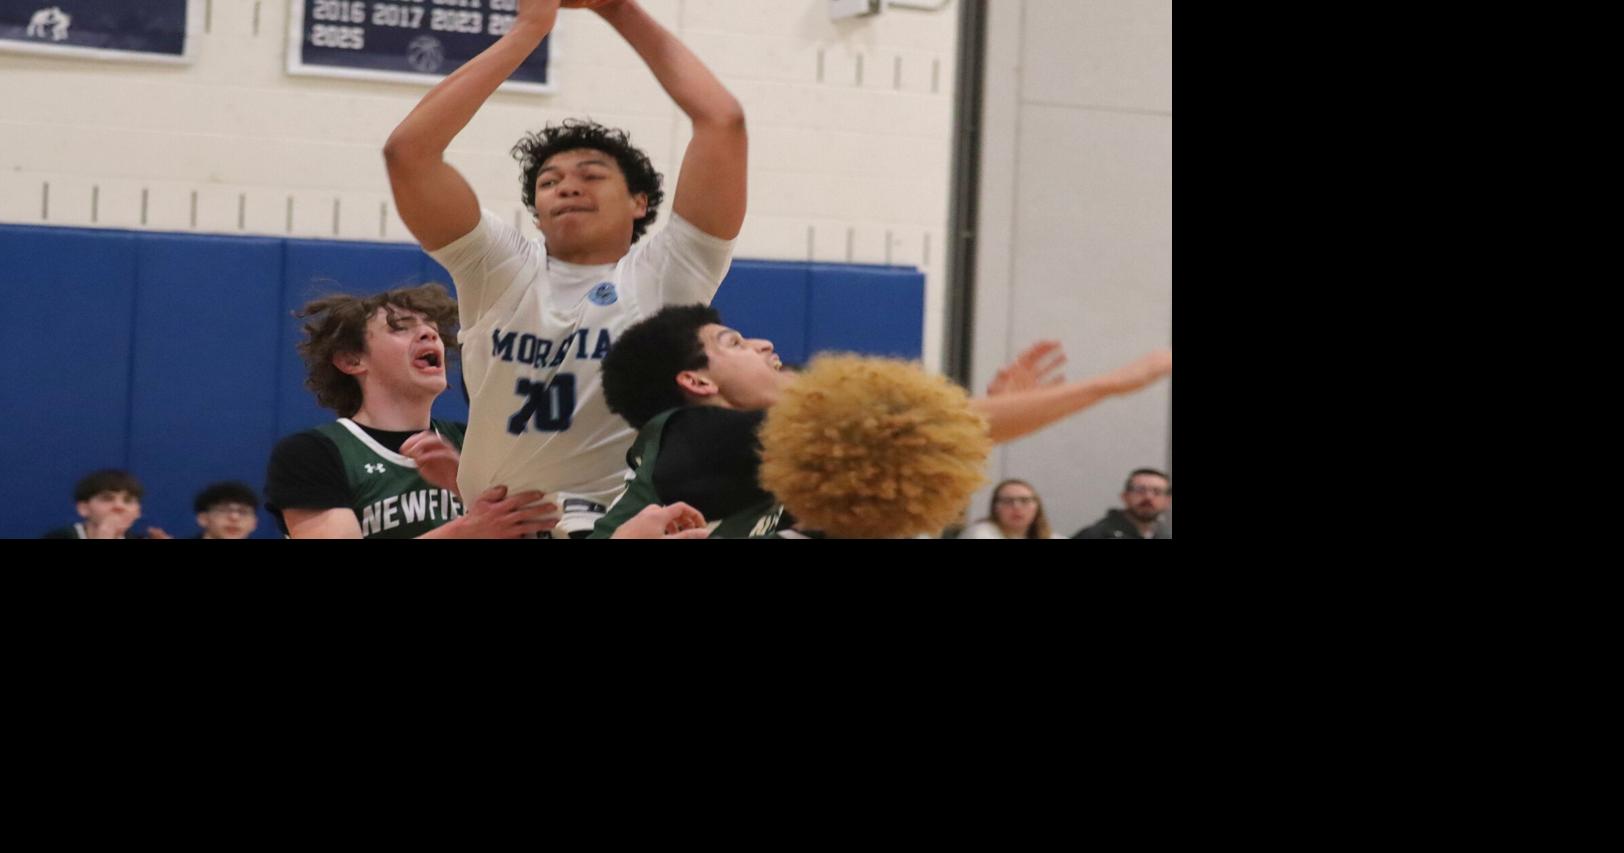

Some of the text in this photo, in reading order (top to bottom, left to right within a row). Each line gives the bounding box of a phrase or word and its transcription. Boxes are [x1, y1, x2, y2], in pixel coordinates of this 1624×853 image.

[313, 0, 366, 23] 2016
[372, 3, 425, 29] 2017
[431, 8, 483, 34] 2023
[312, 24, 365, 50] 2025
